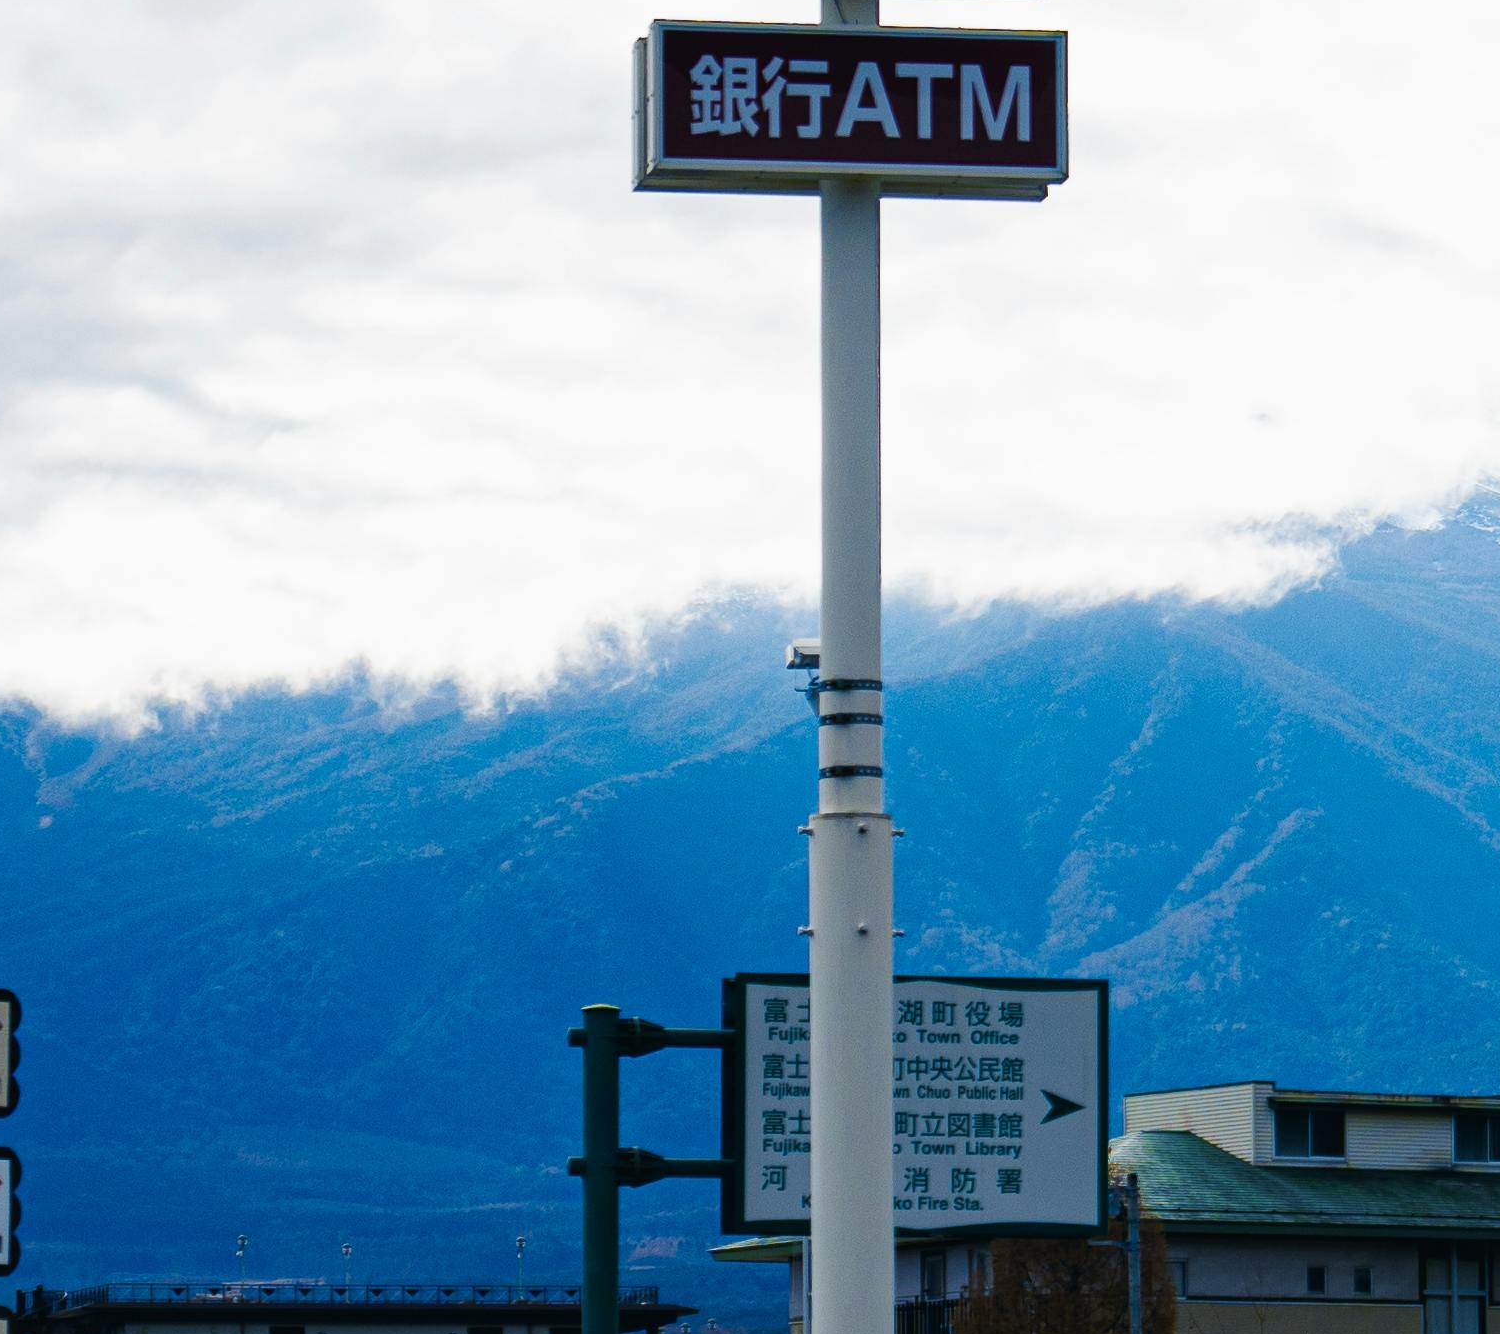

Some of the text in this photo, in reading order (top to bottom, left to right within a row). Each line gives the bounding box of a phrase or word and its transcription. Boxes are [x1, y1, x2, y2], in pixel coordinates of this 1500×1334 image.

[688, 54, 1031, 143] 銀行ATM
[916, 1029, 960, 1043] Town
[971, 1030, 1019, 1045] Office
[917, 1085, 950, 1099] Chuo
[958, 1086, 996, 1100] Public
[1000, 1086, 1024, 1100] Hall
[911, 1141, 955, 1155] Town
[965, 1142, 1022, 1159] Library
[918, 1196, 948, 1210] Fire
[953, 1197, 984, 1210] Sta.
